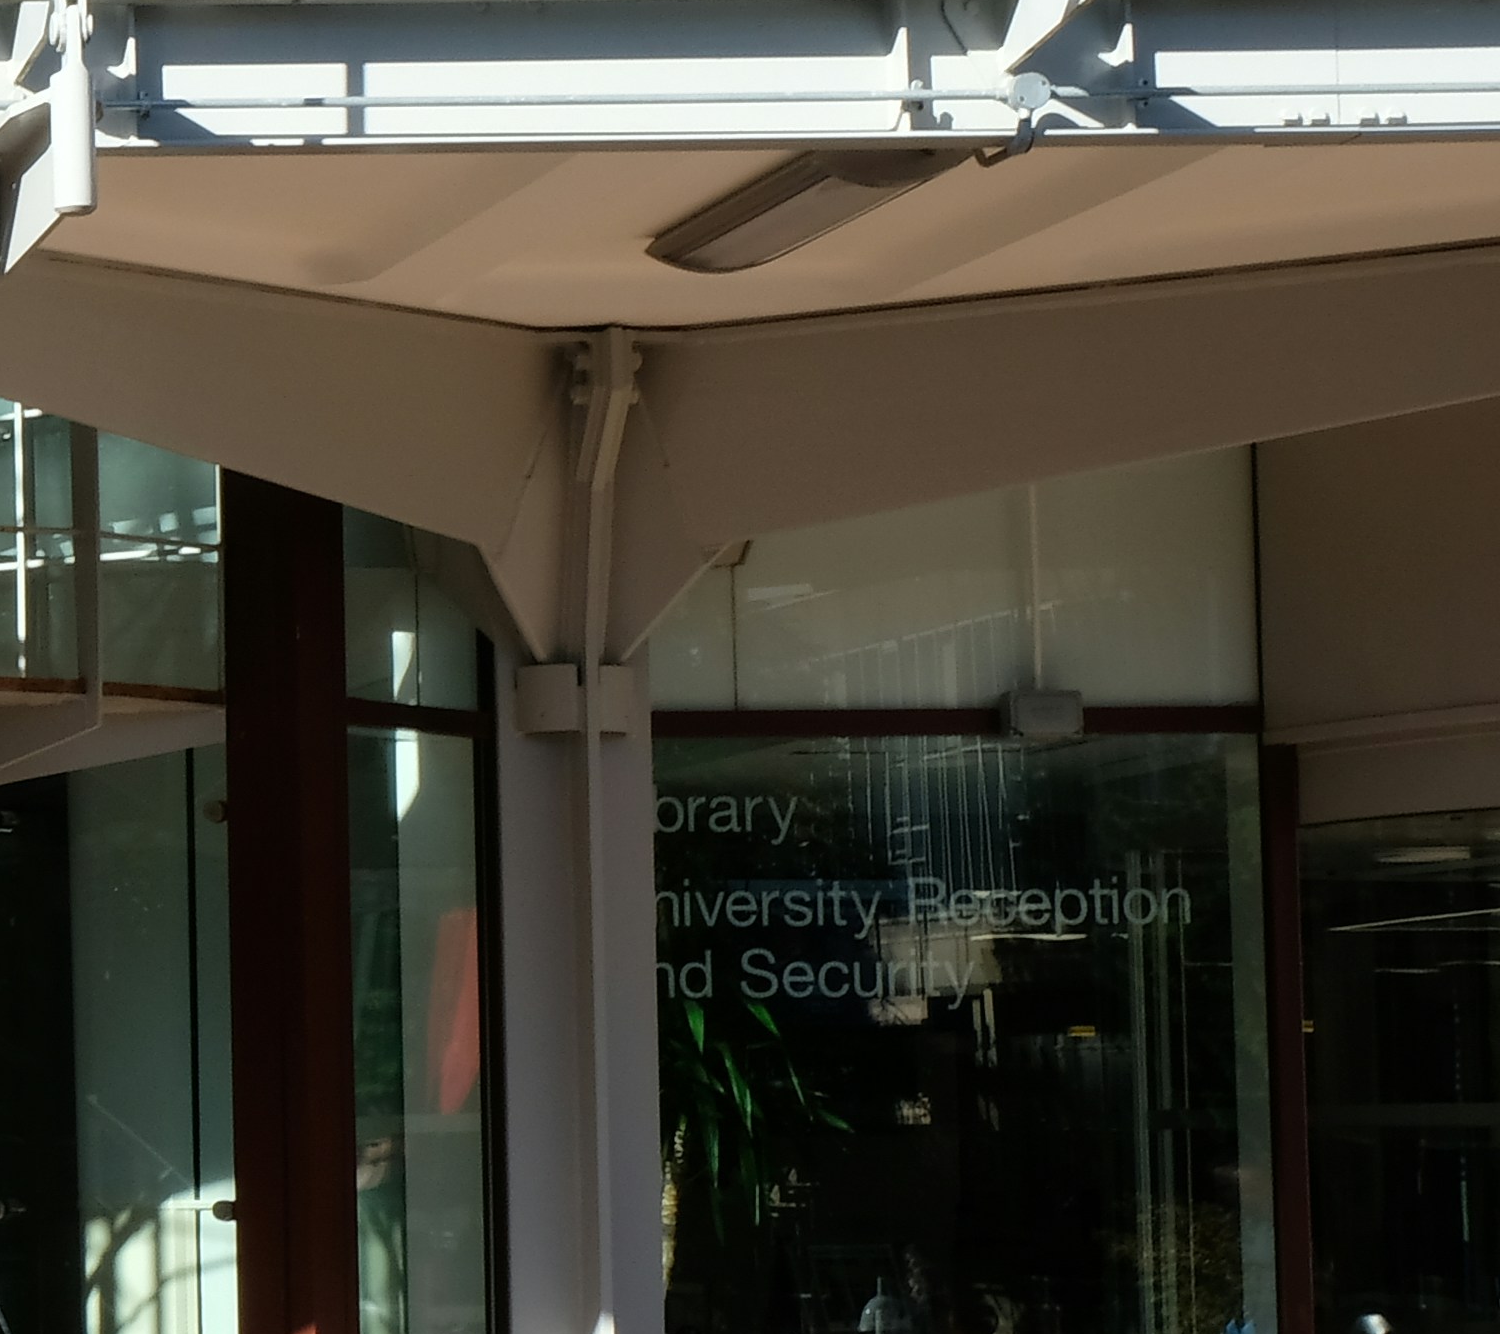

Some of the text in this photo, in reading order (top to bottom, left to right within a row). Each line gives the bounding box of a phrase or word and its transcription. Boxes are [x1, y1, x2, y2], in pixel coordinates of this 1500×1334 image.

[655, 875, 1191, 940] niversity Reception
[655, 947, 975, 1011] nd Security
